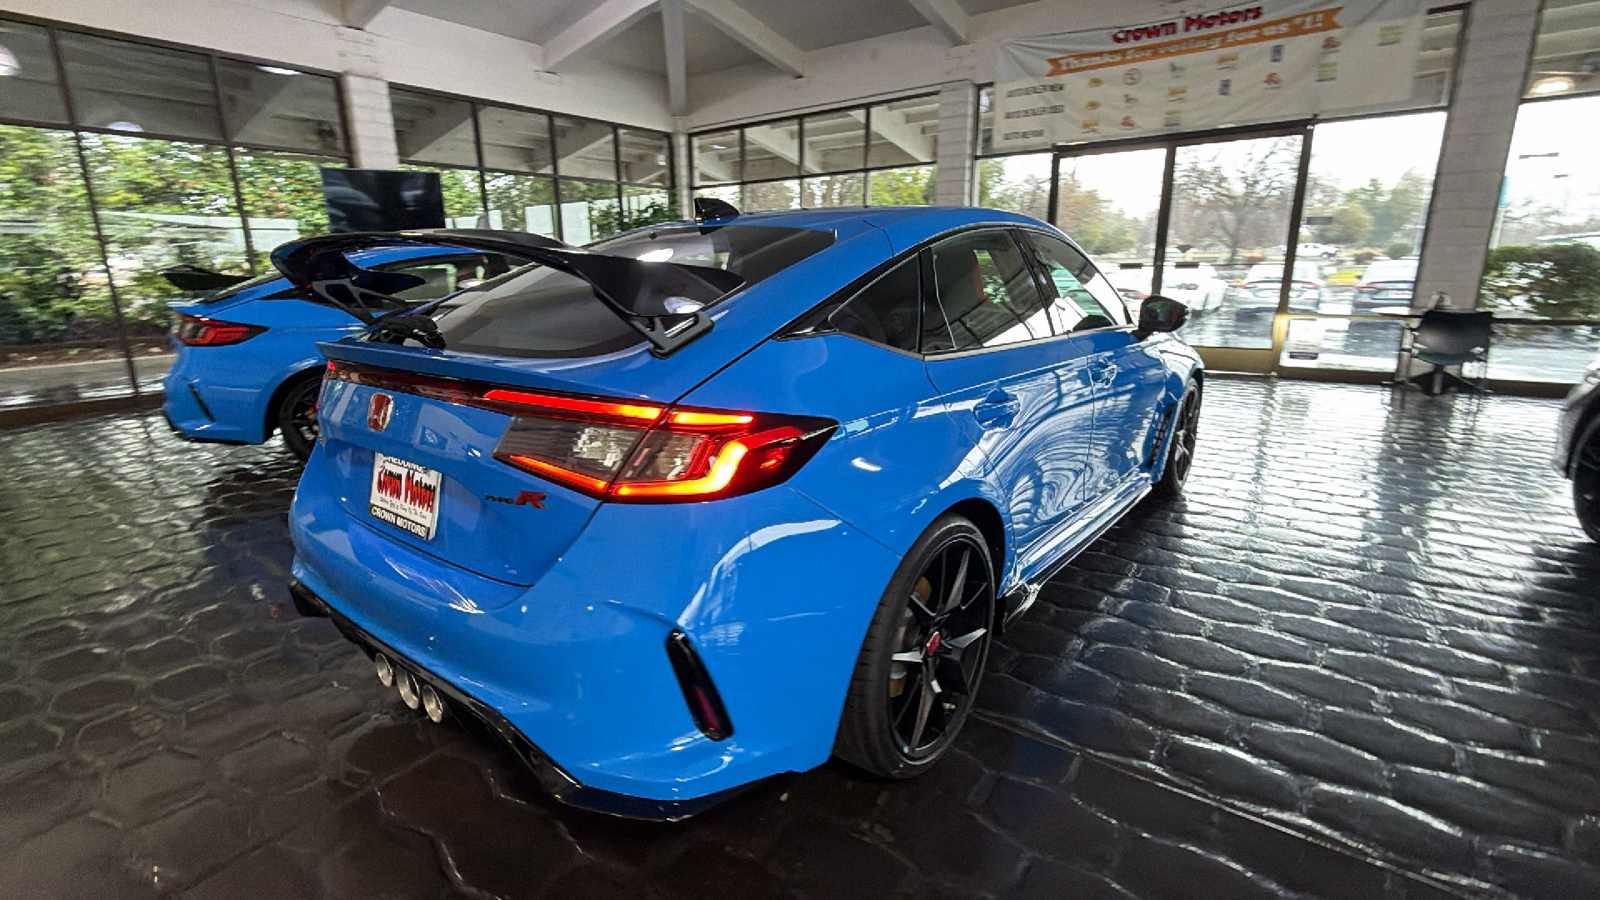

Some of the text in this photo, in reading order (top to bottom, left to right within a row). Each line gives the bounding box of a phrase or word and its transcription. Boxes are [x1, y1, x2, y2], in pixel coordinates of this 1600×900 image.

[1111, 6, 1263, 43] Crown Motors
[1058, 51, 1124, 70] Thanks
[1125, 48, 1154, 59] for
[1156, 37, 1222, 55] voting
[1224, 29, 1259, 42] for
[1263, 23, 1290, 36] us
[371, 506, 396, 525] CROWN
[396, 516, 426, 537] MOTORS
